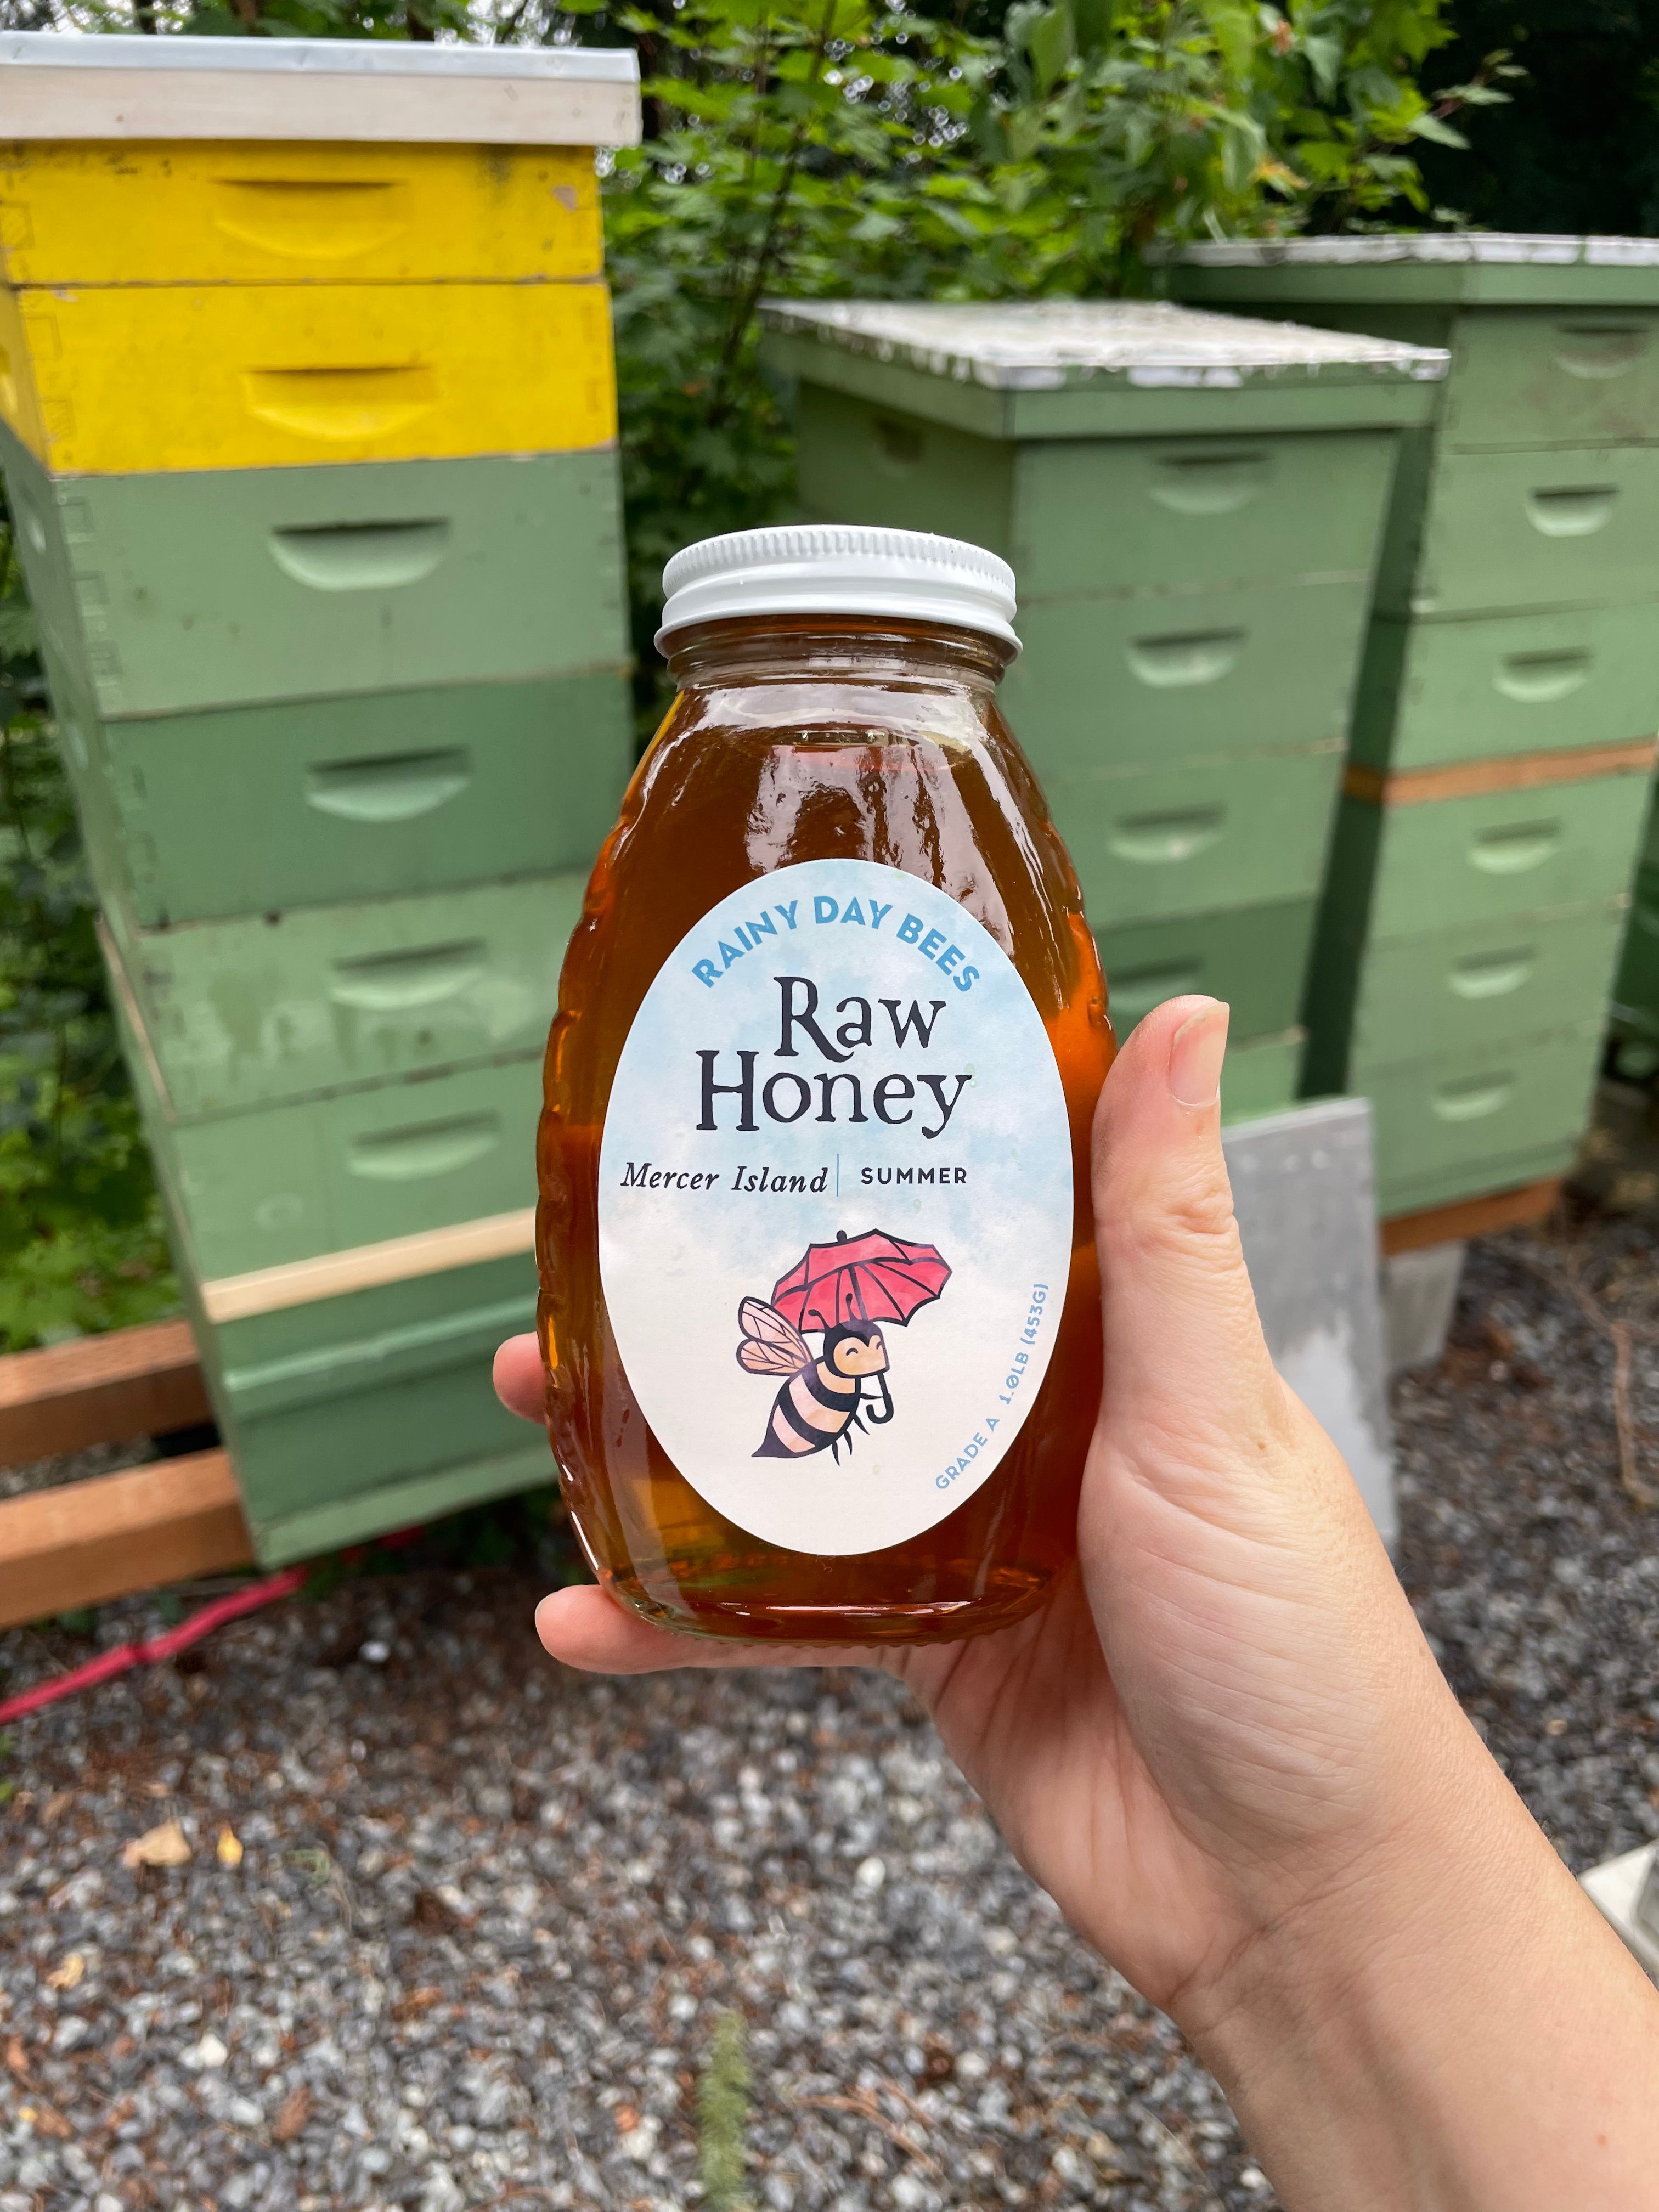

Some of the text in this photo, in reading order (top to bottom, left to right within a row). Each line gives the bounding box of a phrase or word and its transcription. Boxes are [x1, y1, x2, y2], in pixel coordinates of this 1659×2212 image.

[691, 896, 980, 992] RAINY DAY BEES
[774, 976, 946, 1063] Raw
[695, 1049, 972, 1139] Honey
[620, 1161, 967, 1193] Mercer Island SUMMER
[935, 1432, 988, 1489] GRADE
[985, 1418, 1000, 1432] A
[1020, 1283, 1049, 1345] (453G)
